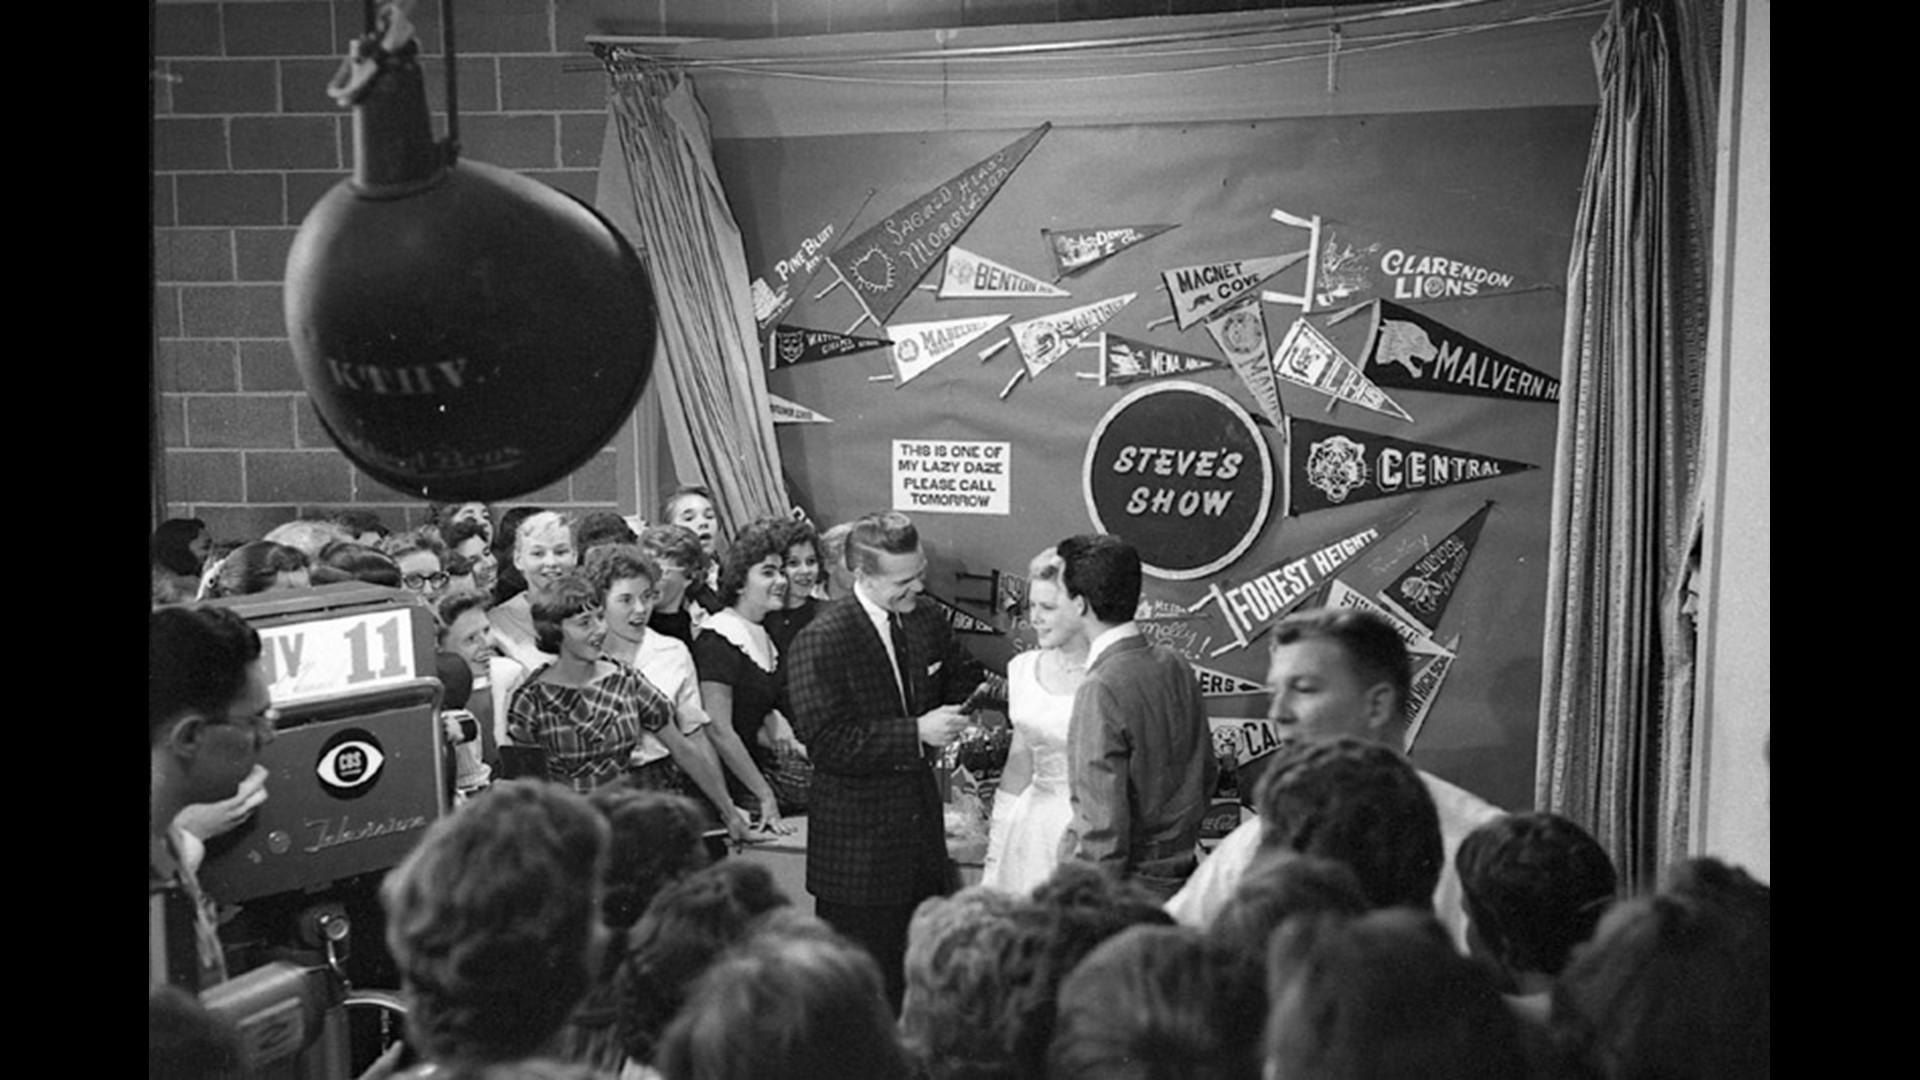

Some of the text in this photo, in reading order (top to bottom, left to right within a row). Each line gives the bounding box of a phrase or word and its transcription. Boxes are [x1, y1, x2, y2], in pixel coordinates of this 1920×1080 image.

[974, 262, 1037, 291] BENTON
[1176, 262, 1242, 293] MAGNET
[1381, 250, 1514, 288] CLARENDON
[1217, 272, 1261, 299] COVE
[1395, 276, 1479, 299] LIONS
[1432, 339, 1543, 400] MALVERN
[901, 444, 1003, 458] THIS IS ONE OF
[1112, 446, 1243, 479] STEVE'S
[899, 460, 1003, 475] MY LAZY DAZE
[1376, 448, 1502, 491] CENTRAL
[904, 478, 996, 492] PLEASE CALL
[911, 493, 990, 507] TOMORROW
[1126, 486, 1233, 516] SHOW
[1225, 557, 1315, 632] FOREST
[1311, 527, 1379, 576] HEIGHTS
[344, 616, 408, 684] 11
[1242, 722, 1282, 757] CA
[337, 751, 363, 771] CBS
